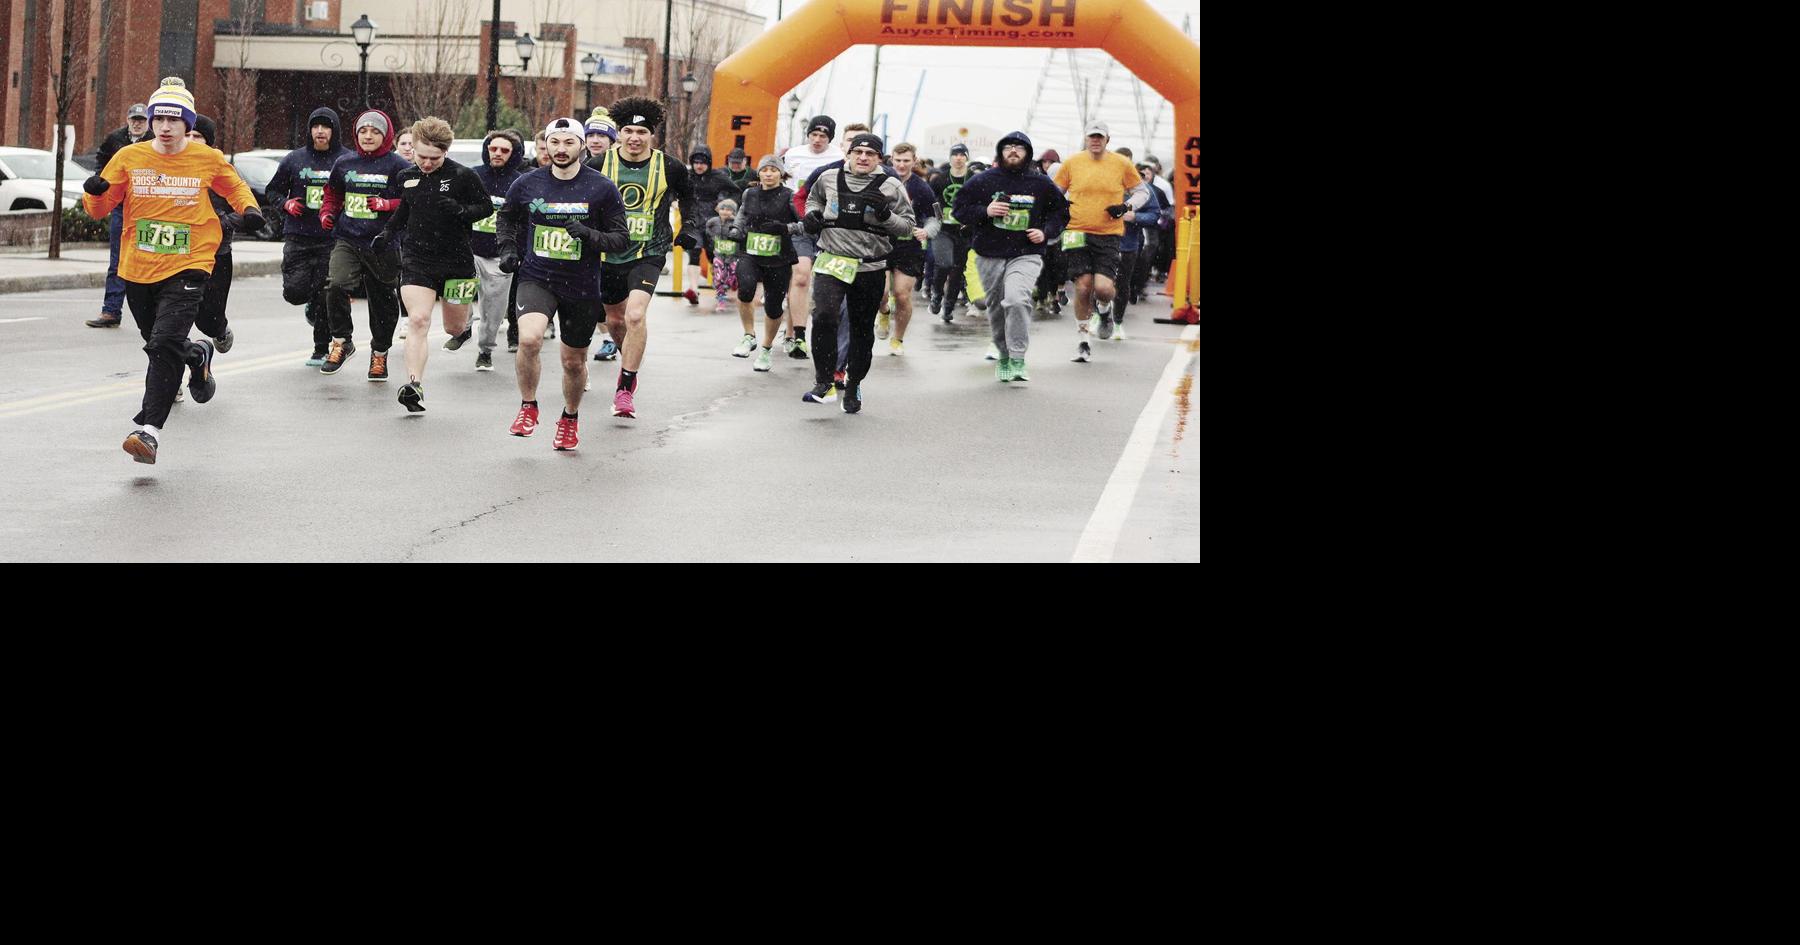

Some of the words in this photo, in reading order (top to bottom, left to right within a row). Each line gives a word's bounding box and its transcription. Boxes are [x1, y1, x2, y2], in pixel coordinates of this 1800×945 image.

[881, 0, 1076, 27] FINISH
[881, 26, 1075, 38] AuyerTiming.com
[132, 175, 157, 186] CROSS
[166, 176, 202, 188] COUNTRY
[440, 183, 450, 192] 25
[150, 223, 175, 246] 73
[541, 230, 574, 252] 102
[752, 235, 776, 252] 137
[825, 257, 847, 275] 42
[457, 282, 476, 299] 12
